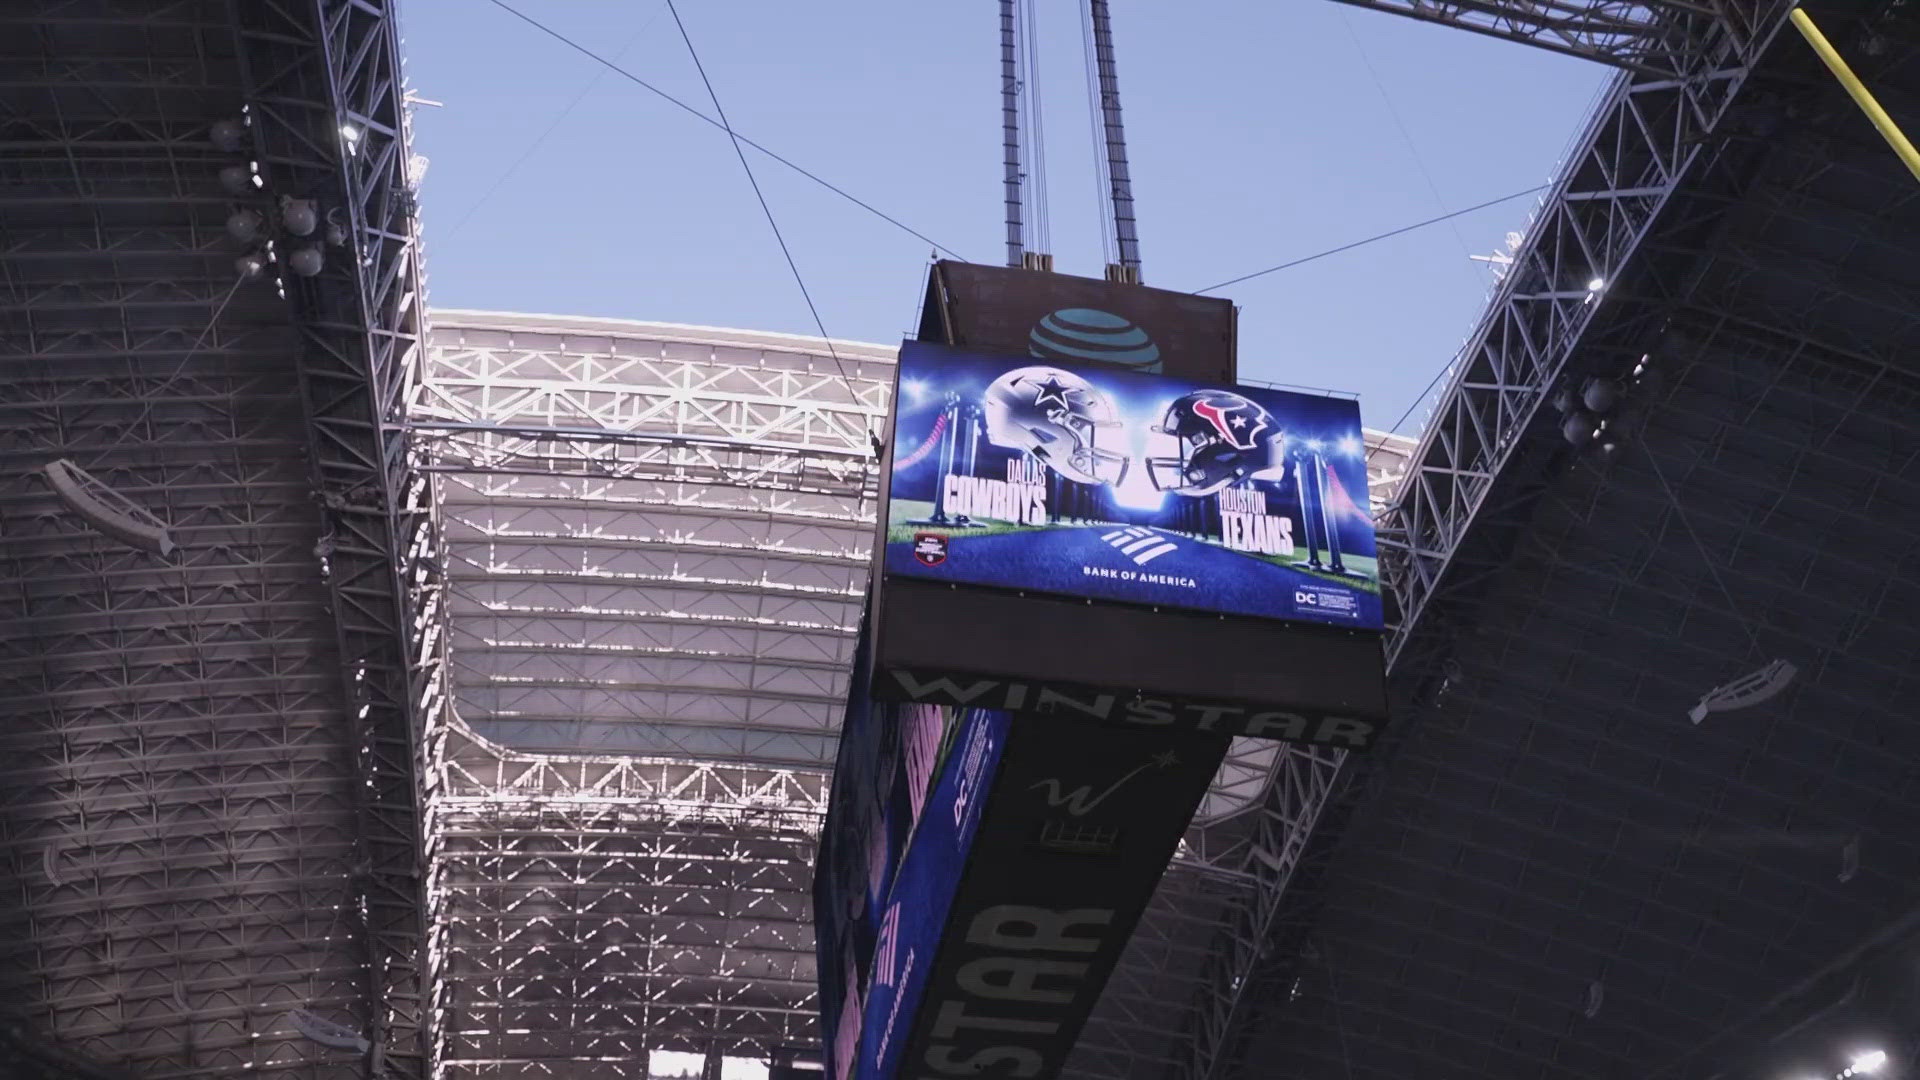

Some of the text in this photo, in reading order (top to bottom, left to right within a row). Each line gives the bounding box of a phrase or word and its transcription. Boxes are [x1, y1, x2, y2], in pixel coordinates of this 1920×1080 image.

[1007, 456, 1046, 486] DALLAS
[943, 473, 1047, 526] COWBOYS
[1219, 487, 1266, 514] HOUSTON
[1220, 510, 1294, 556] TEXANS
[1083, 566, 1196, 588] BANK OF AMERICA
[1295, 591, 1317, 605] DC
[891, 671, 1374, 745] WINSTAR
[922, 904, 1114, 1080] STAR
